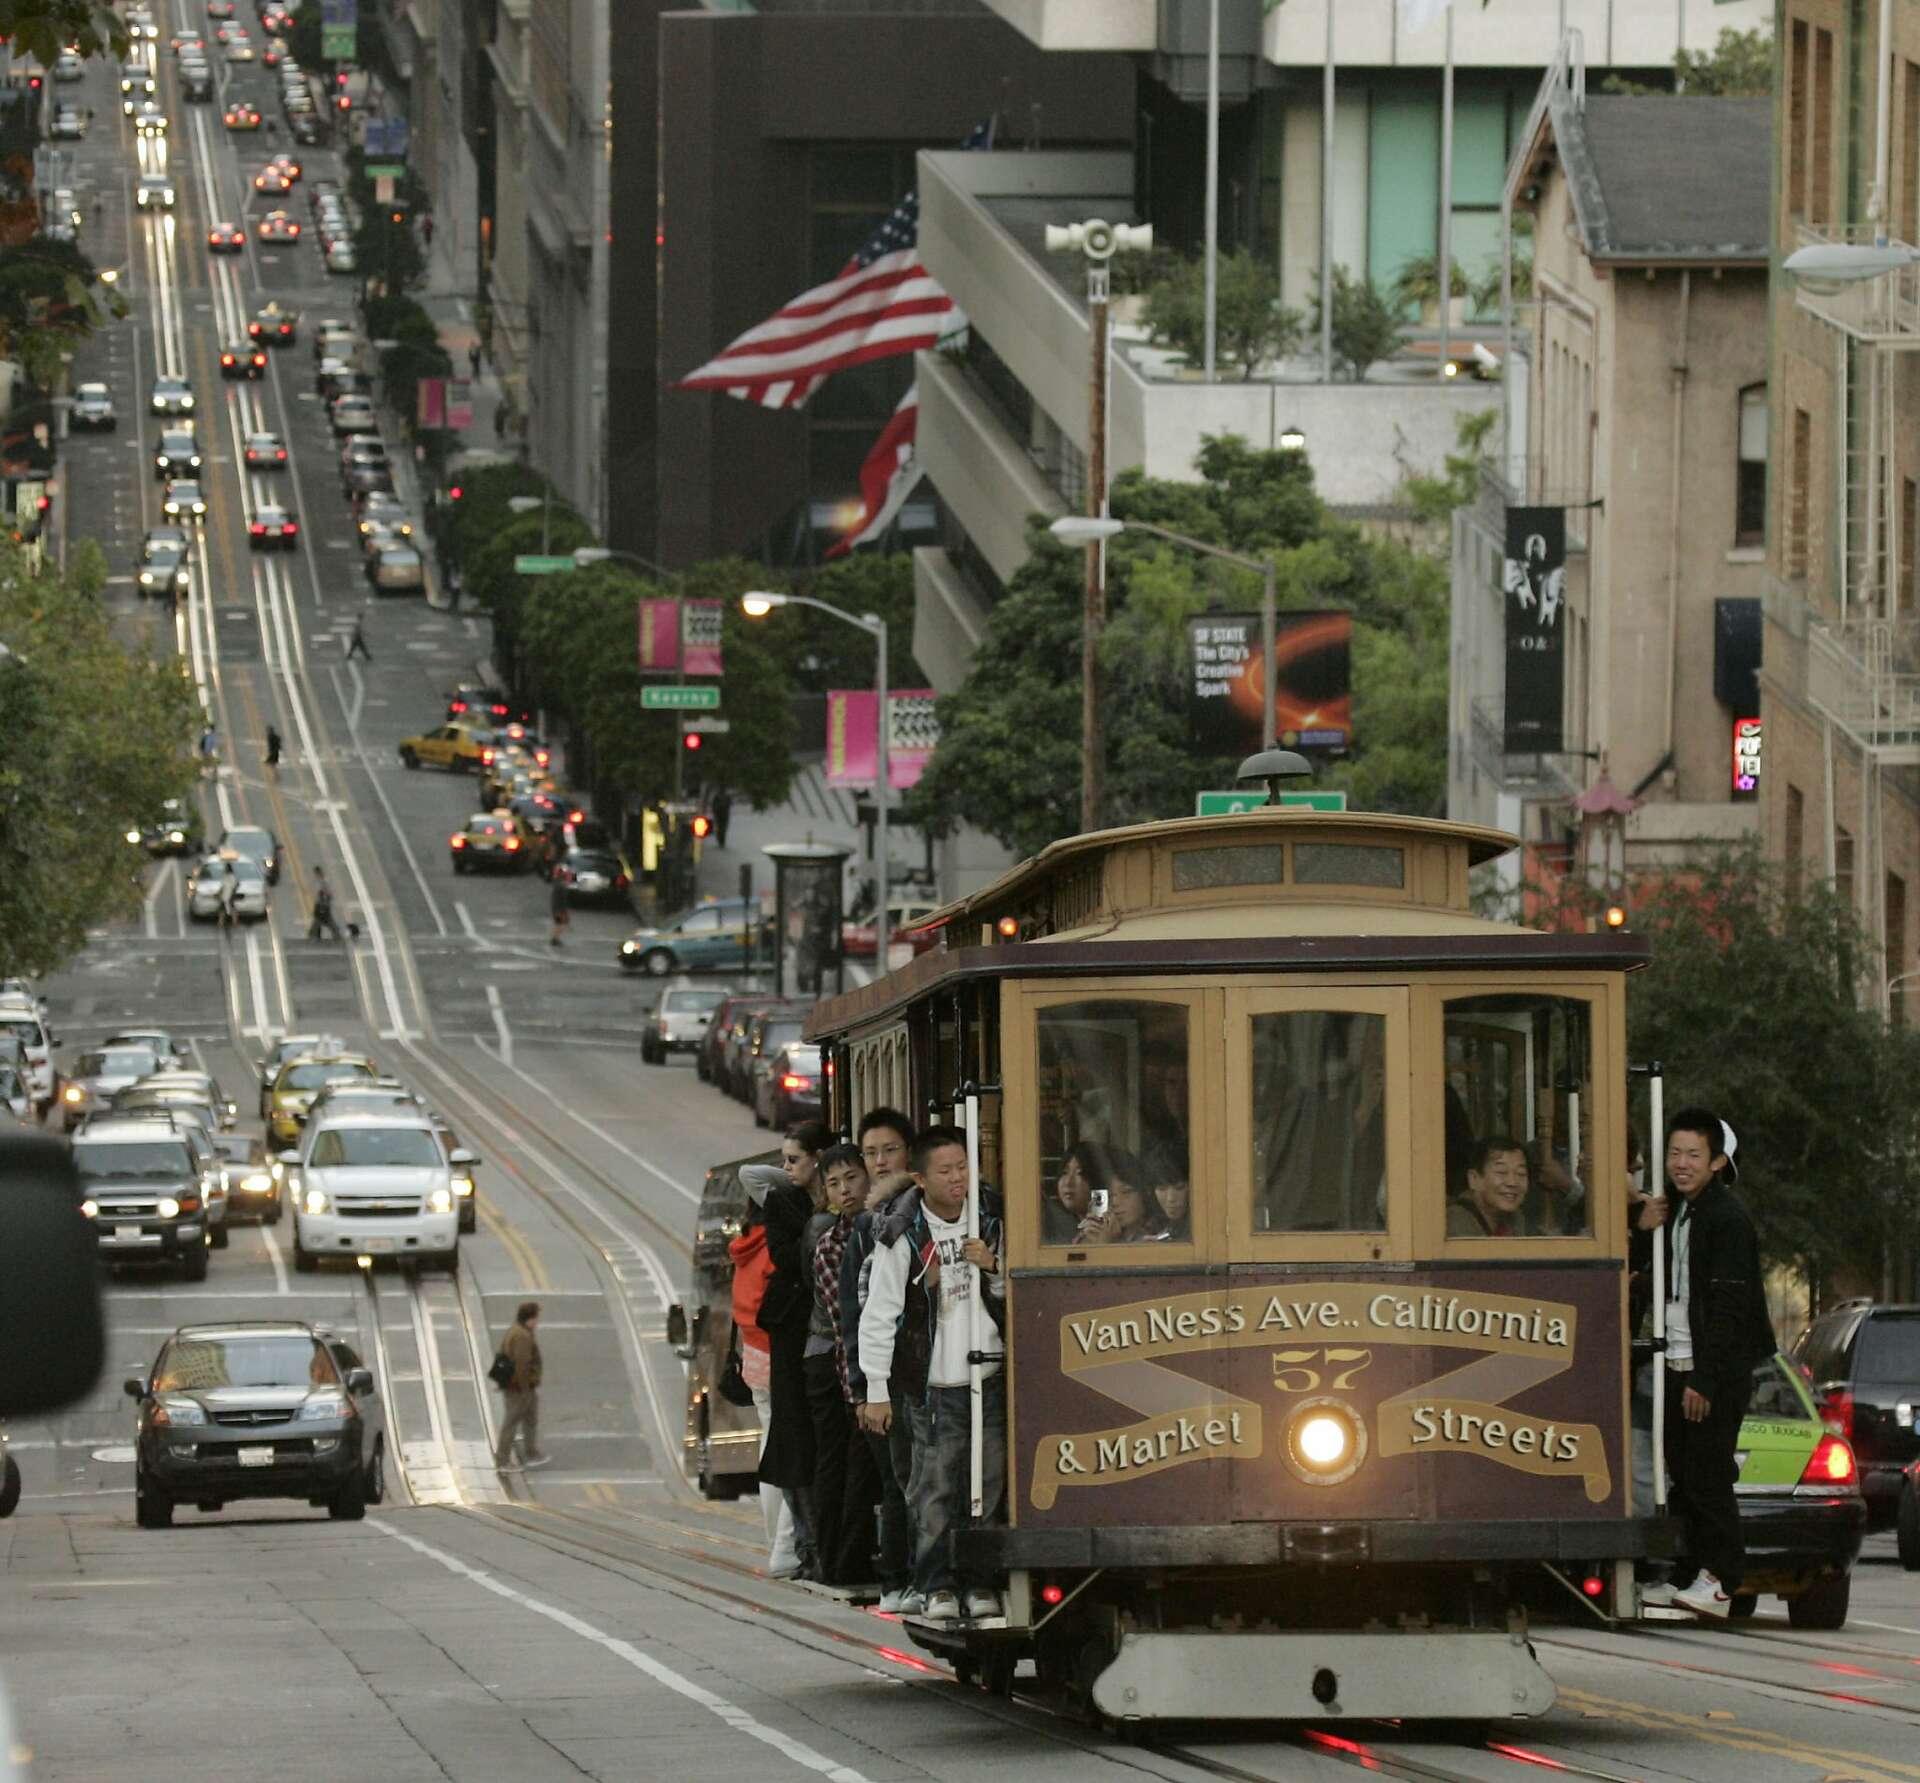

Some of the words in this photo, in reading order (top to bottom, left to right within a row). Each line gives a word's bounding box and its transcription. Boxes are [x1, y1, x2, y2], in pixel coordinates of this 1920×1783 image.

[1212, 627, 1246, 643] STATE
[1195, 645, 1217, 660] The
[1218, 644, 1249, 662] City's
[1195, 662, 1244, 679] Creative
[1196, 680, 1231, 698] Spark
[1069, 1318, 1142, 1355] Van
[1145, 1306, 1246, 1343] Ness
[1368, 1294, 1568, 1346] California
[1272, 1348, 1373, 1393] 57
[1056, 1439, 1088, 1475] &
[1093, 1411, 1244, 1475] Market
[1411, 1406, 1581, 1460] Streets
